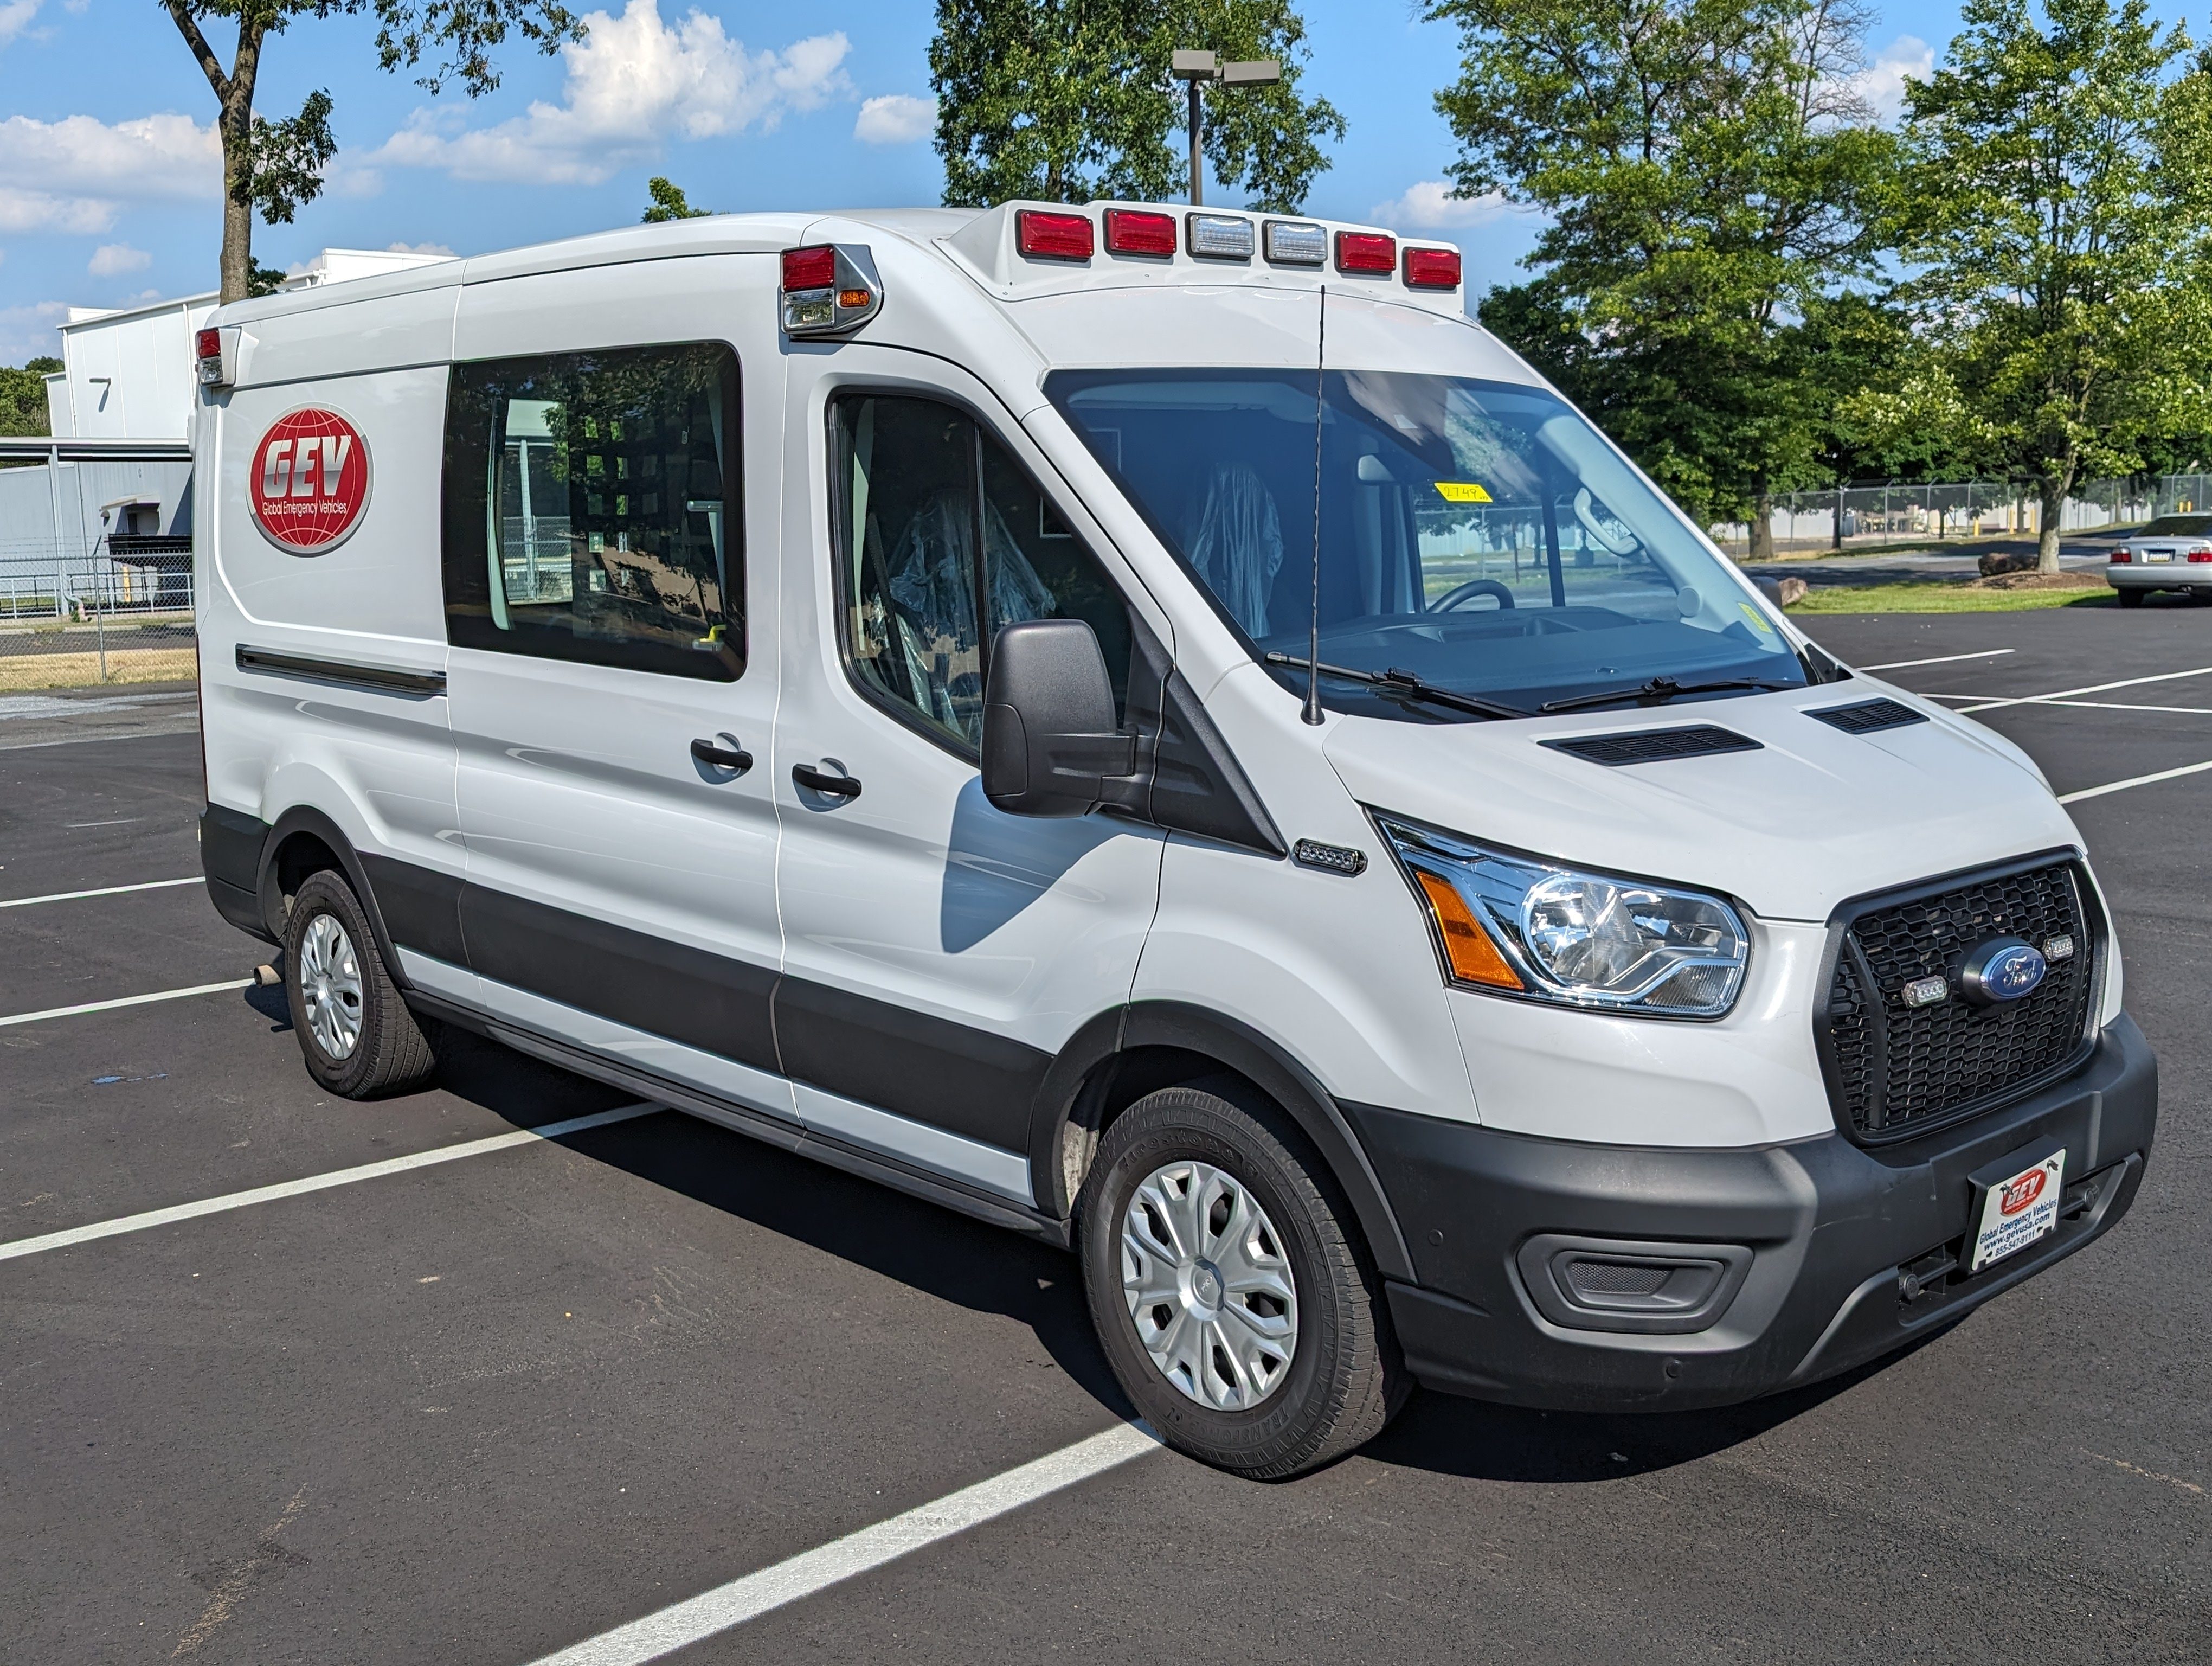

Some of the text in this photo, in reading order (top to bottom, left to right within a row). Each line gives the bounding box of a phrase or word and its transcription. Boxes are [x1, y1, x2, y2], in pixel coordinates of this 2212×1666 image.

[263, 435, 351, 498] GEV
[262, 499, 346, 517] Global Emergency Vehicles
[2003, 956, 2036, 986] Ford
[2006, 1174, 2041, 1207] GEV
[1979, 1226, 1999, 1244] Global
[1999, 1211, 2032, 1234] Emergency
[2033, 1199, 2057, 1216] Vehicles
[1984, 1213, 2050, 1251] www.gevusa.com
